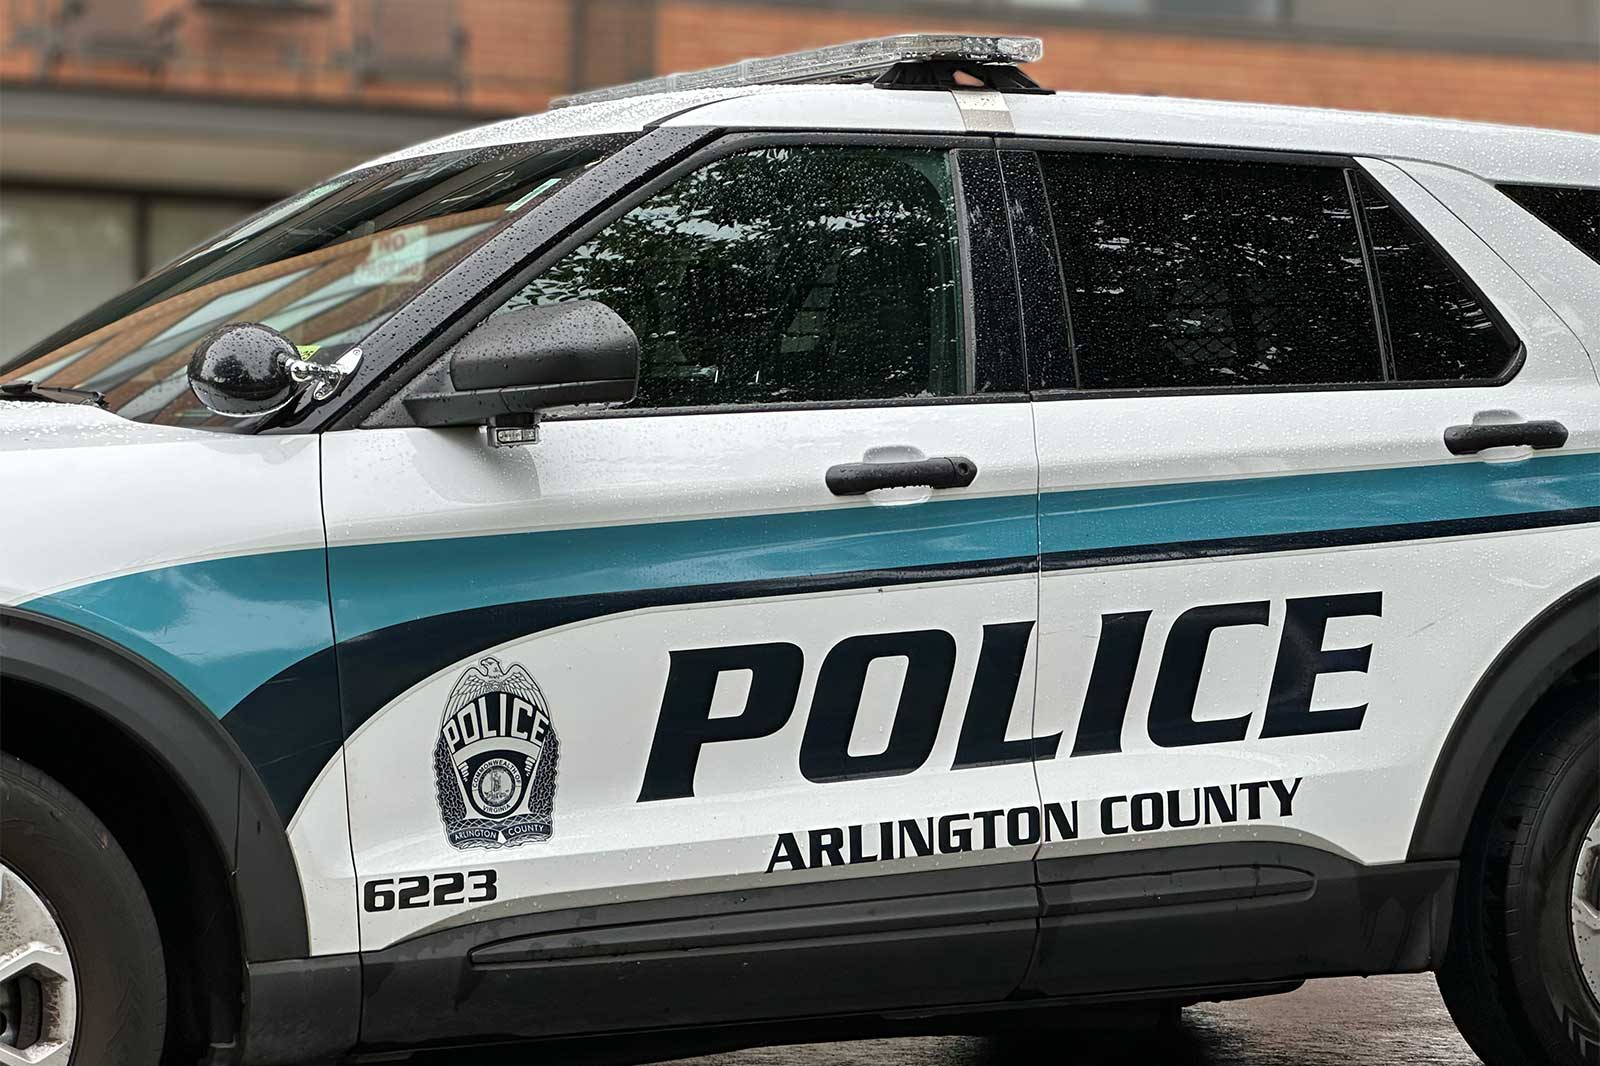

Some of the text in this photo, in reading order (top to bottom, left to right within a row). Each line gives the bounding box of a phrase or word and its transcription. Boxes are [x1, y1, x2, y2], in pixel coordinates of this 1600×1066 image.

[442, 693, 549, 751] POLICE
[636, 591, 1383, 803] POLICE
[454, 824, 544, 841] ARLINGTON COUNTY
[765, 777, 1303, 874] ARLINGTON COUNTY
[364, 870, 497, 912] 6223
